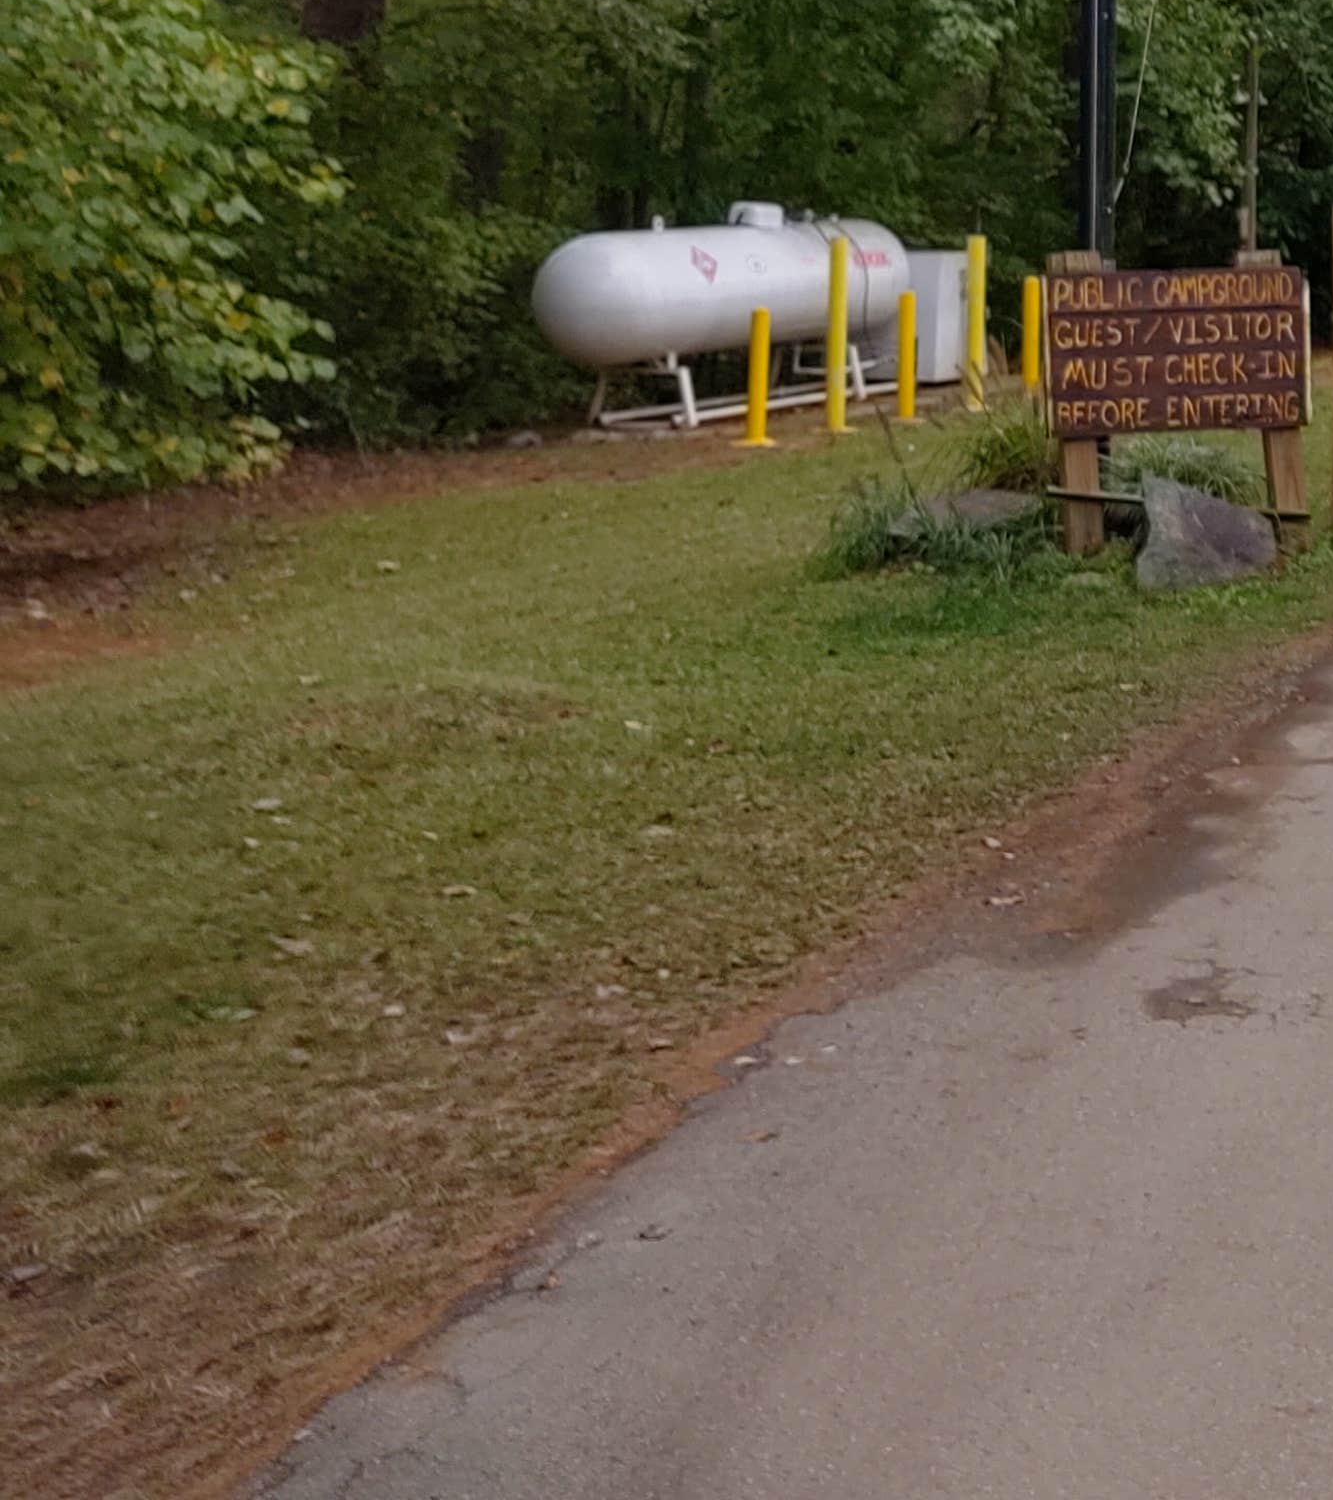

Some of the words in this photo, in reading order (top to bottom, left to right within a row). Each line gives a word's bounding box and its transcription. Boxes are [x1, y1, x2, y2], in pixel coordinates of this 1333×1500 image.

[1054, 279, 1143, 310] PUBLIC
[1153, 273, 1292, 304] CAMPGROUND
[1062, 357, 1153, 390] MUST
[1165, 351, 1296, 385] CHECK-IN
[1057, 399, 1150, 428] BEFORE
[1167, 392, 1298, 426] ENTERING
